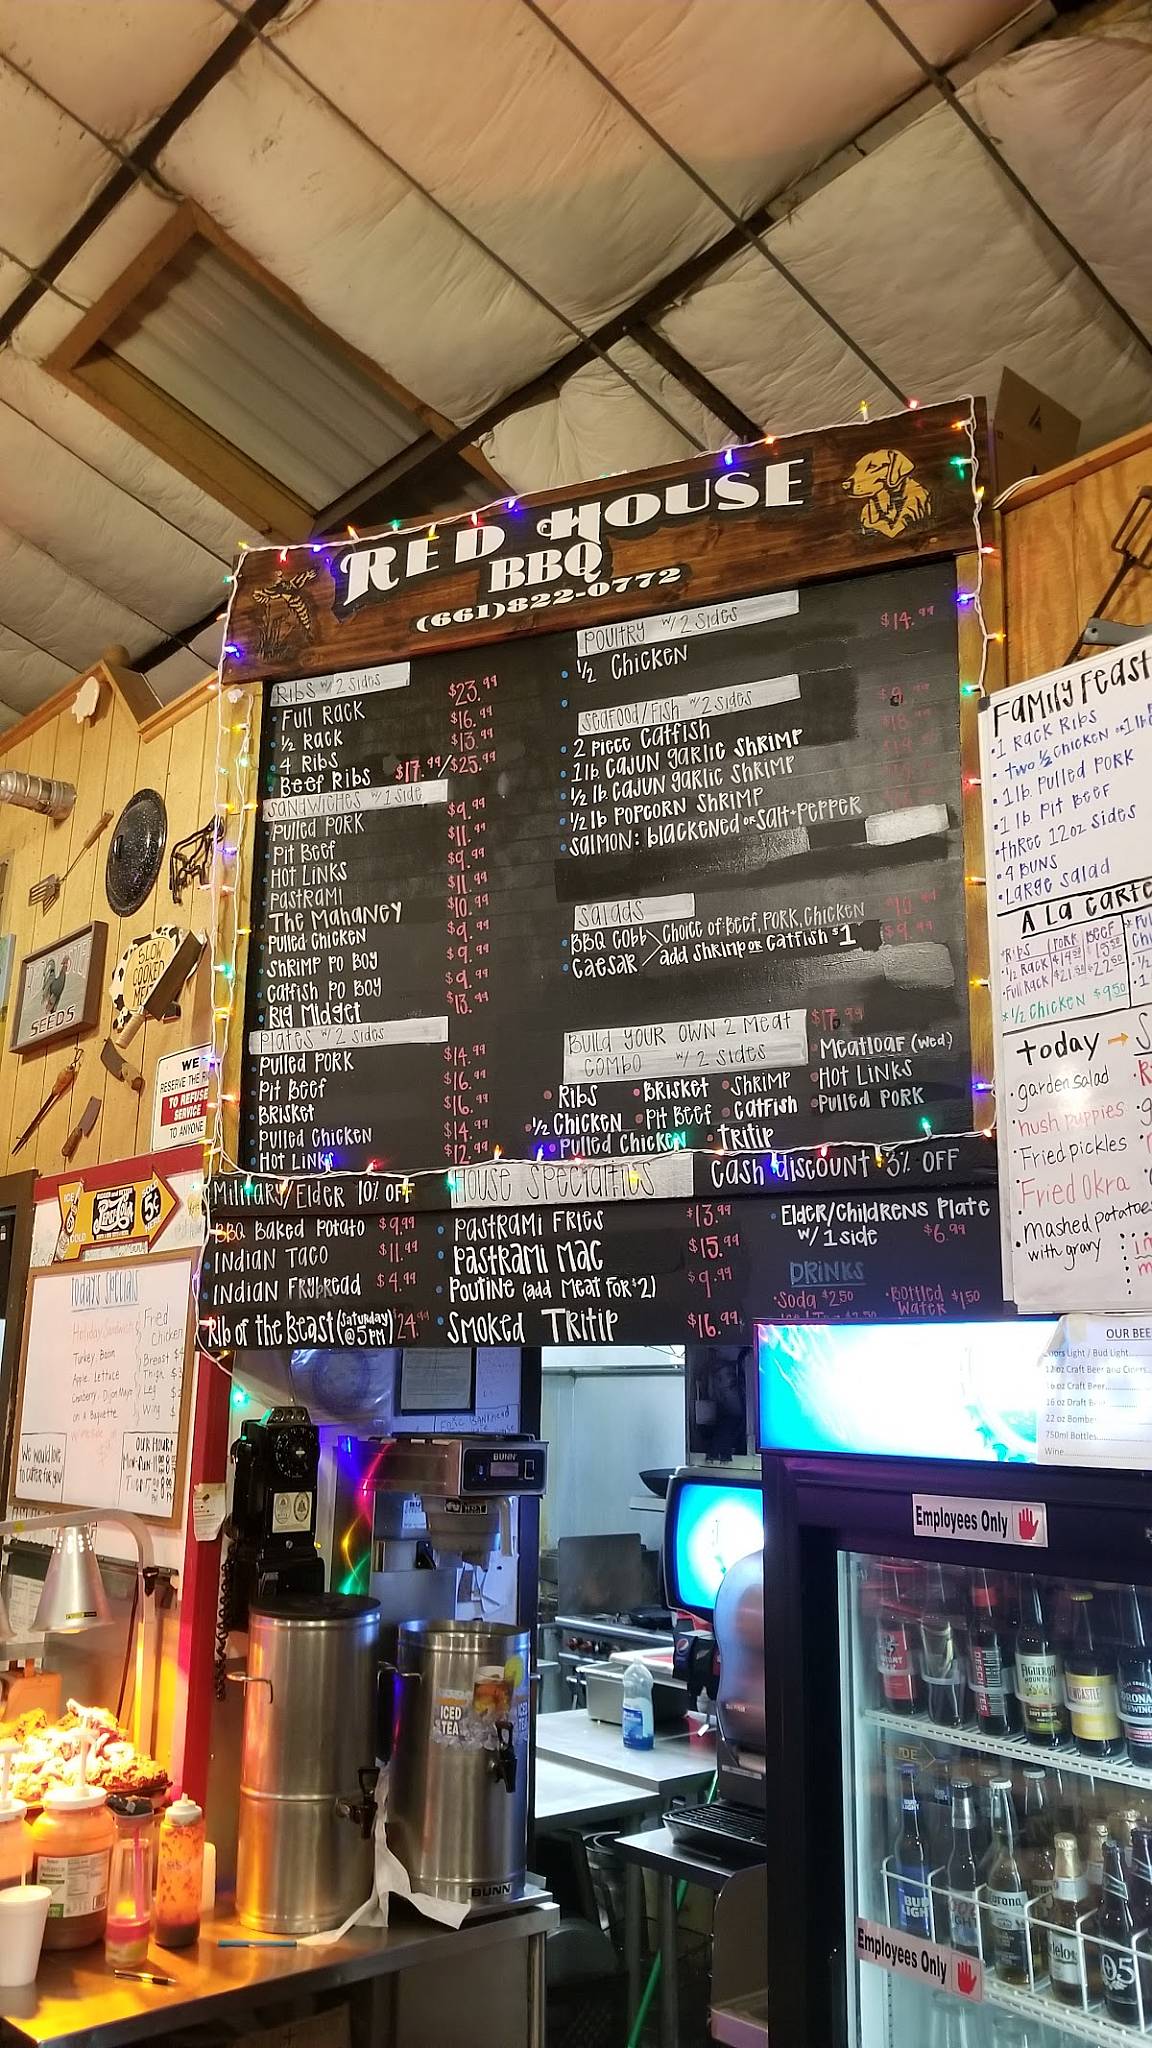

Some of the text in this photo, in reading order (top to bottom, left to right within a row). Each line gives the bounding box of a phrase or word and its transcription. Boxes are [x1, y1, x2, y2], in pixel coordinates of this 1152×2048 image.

[340, 459, 804, 606] RED HOUSE
[488, 541, 603, 593] BBQ
[416, 567, 681, 633] (661)822-0772
[680, 615, 692, 634] 2
[573, 739, 585, 758] 2
[280, 757, 290, 775] 4
[269, 911, 304, 933] The
[1022, 911, 1035, 933] A
[570, 931, 606, 954] BBQ
[30, 1005, 75, 1037] SEEDS
[724, 1019, 736, 1035] 2
[182, 1057, 199, 1071] WE
[160, 1073, 199, 1093] RESERVE THE
[1018, 1065, 1109, 1112] garden salad
[169, 1088, 208, 1109] TO REFUSE
[174, 1104, 201, 1121] SERVICE
[170, 1121, 203, 1138] TO ANYONE
[1019, 1113, 1059, 1136] hush
[923, 1149, 959, 1172] OFF
[1020, 1136, 1127, 1170] Fried pickles
[358, 1180, 379, 1205] 10%
[1021, 1169, 1130, 1209] Fried Okra
[1028, 1244, 1063, 1262] with
[256, 1312, 282, 1345] the
[1107, 1329, 1132, 1339] OUR
[1067, 1349, 1084, 1358] Light
[1110, 1349, 1128, 1358] Light
[1067, 1382, 1085, 1390] Craft
[916, 1506, 1008, 1538] Employees Only
[441, 1706, 462, 1720] ICED
[442, 1721, 459, 1735] TEA
[472, 1883, 512, 1896] BUNN
[858, 1928, 947, 1984] Employees Only
